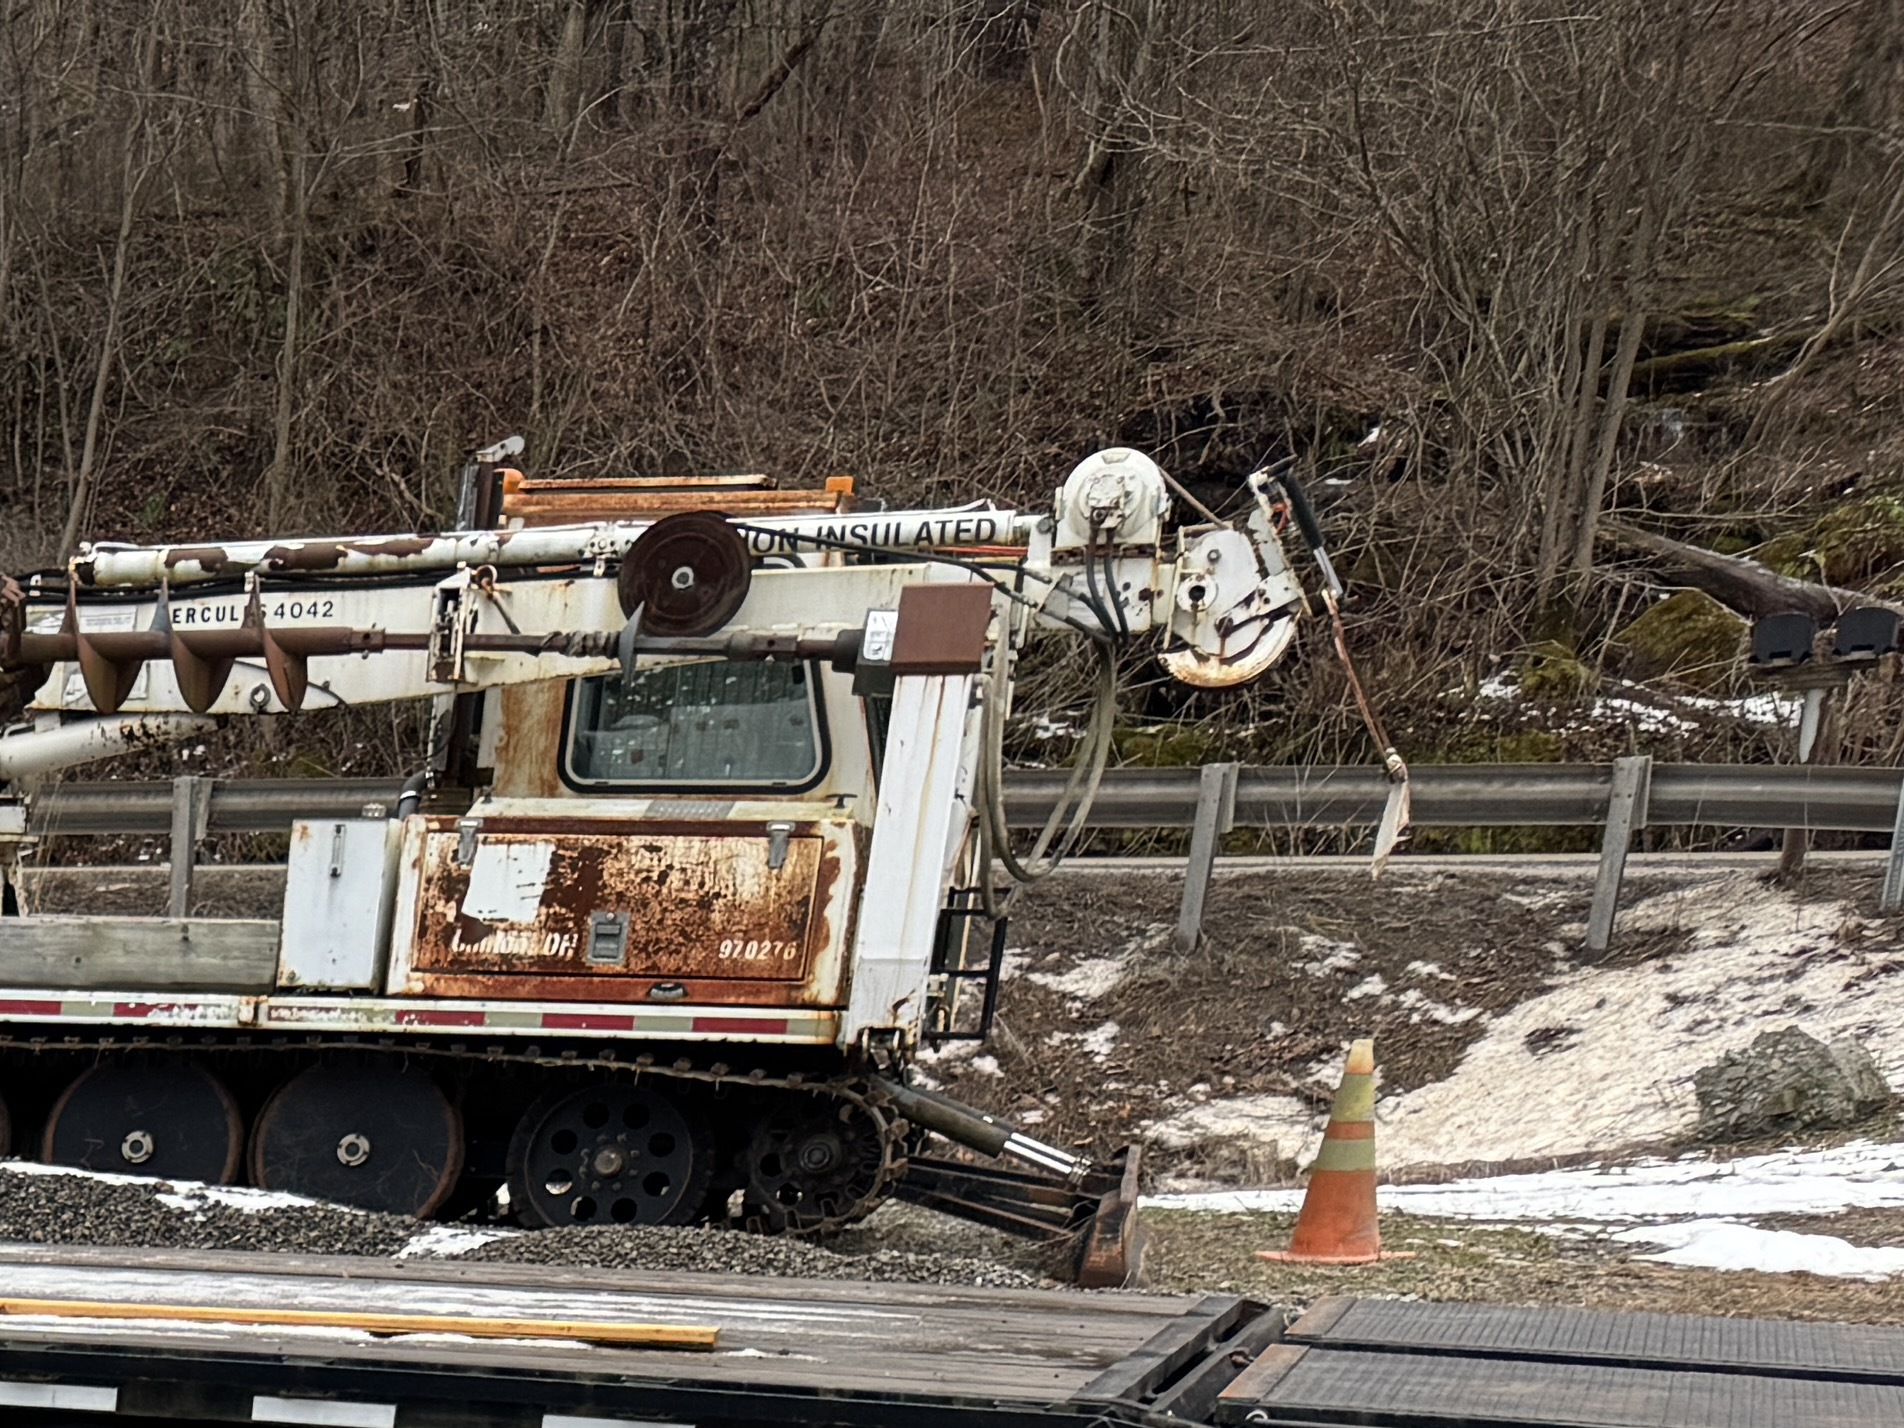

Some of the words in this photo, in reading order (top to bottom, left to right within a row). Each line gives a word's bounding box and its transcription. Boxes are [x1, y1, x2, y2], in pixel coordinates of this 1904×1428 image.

[816, 517, 997, 548] INSULATED
[172, 603, 267, 624] ERCULS
[273, 601, 334, 620] 4042
